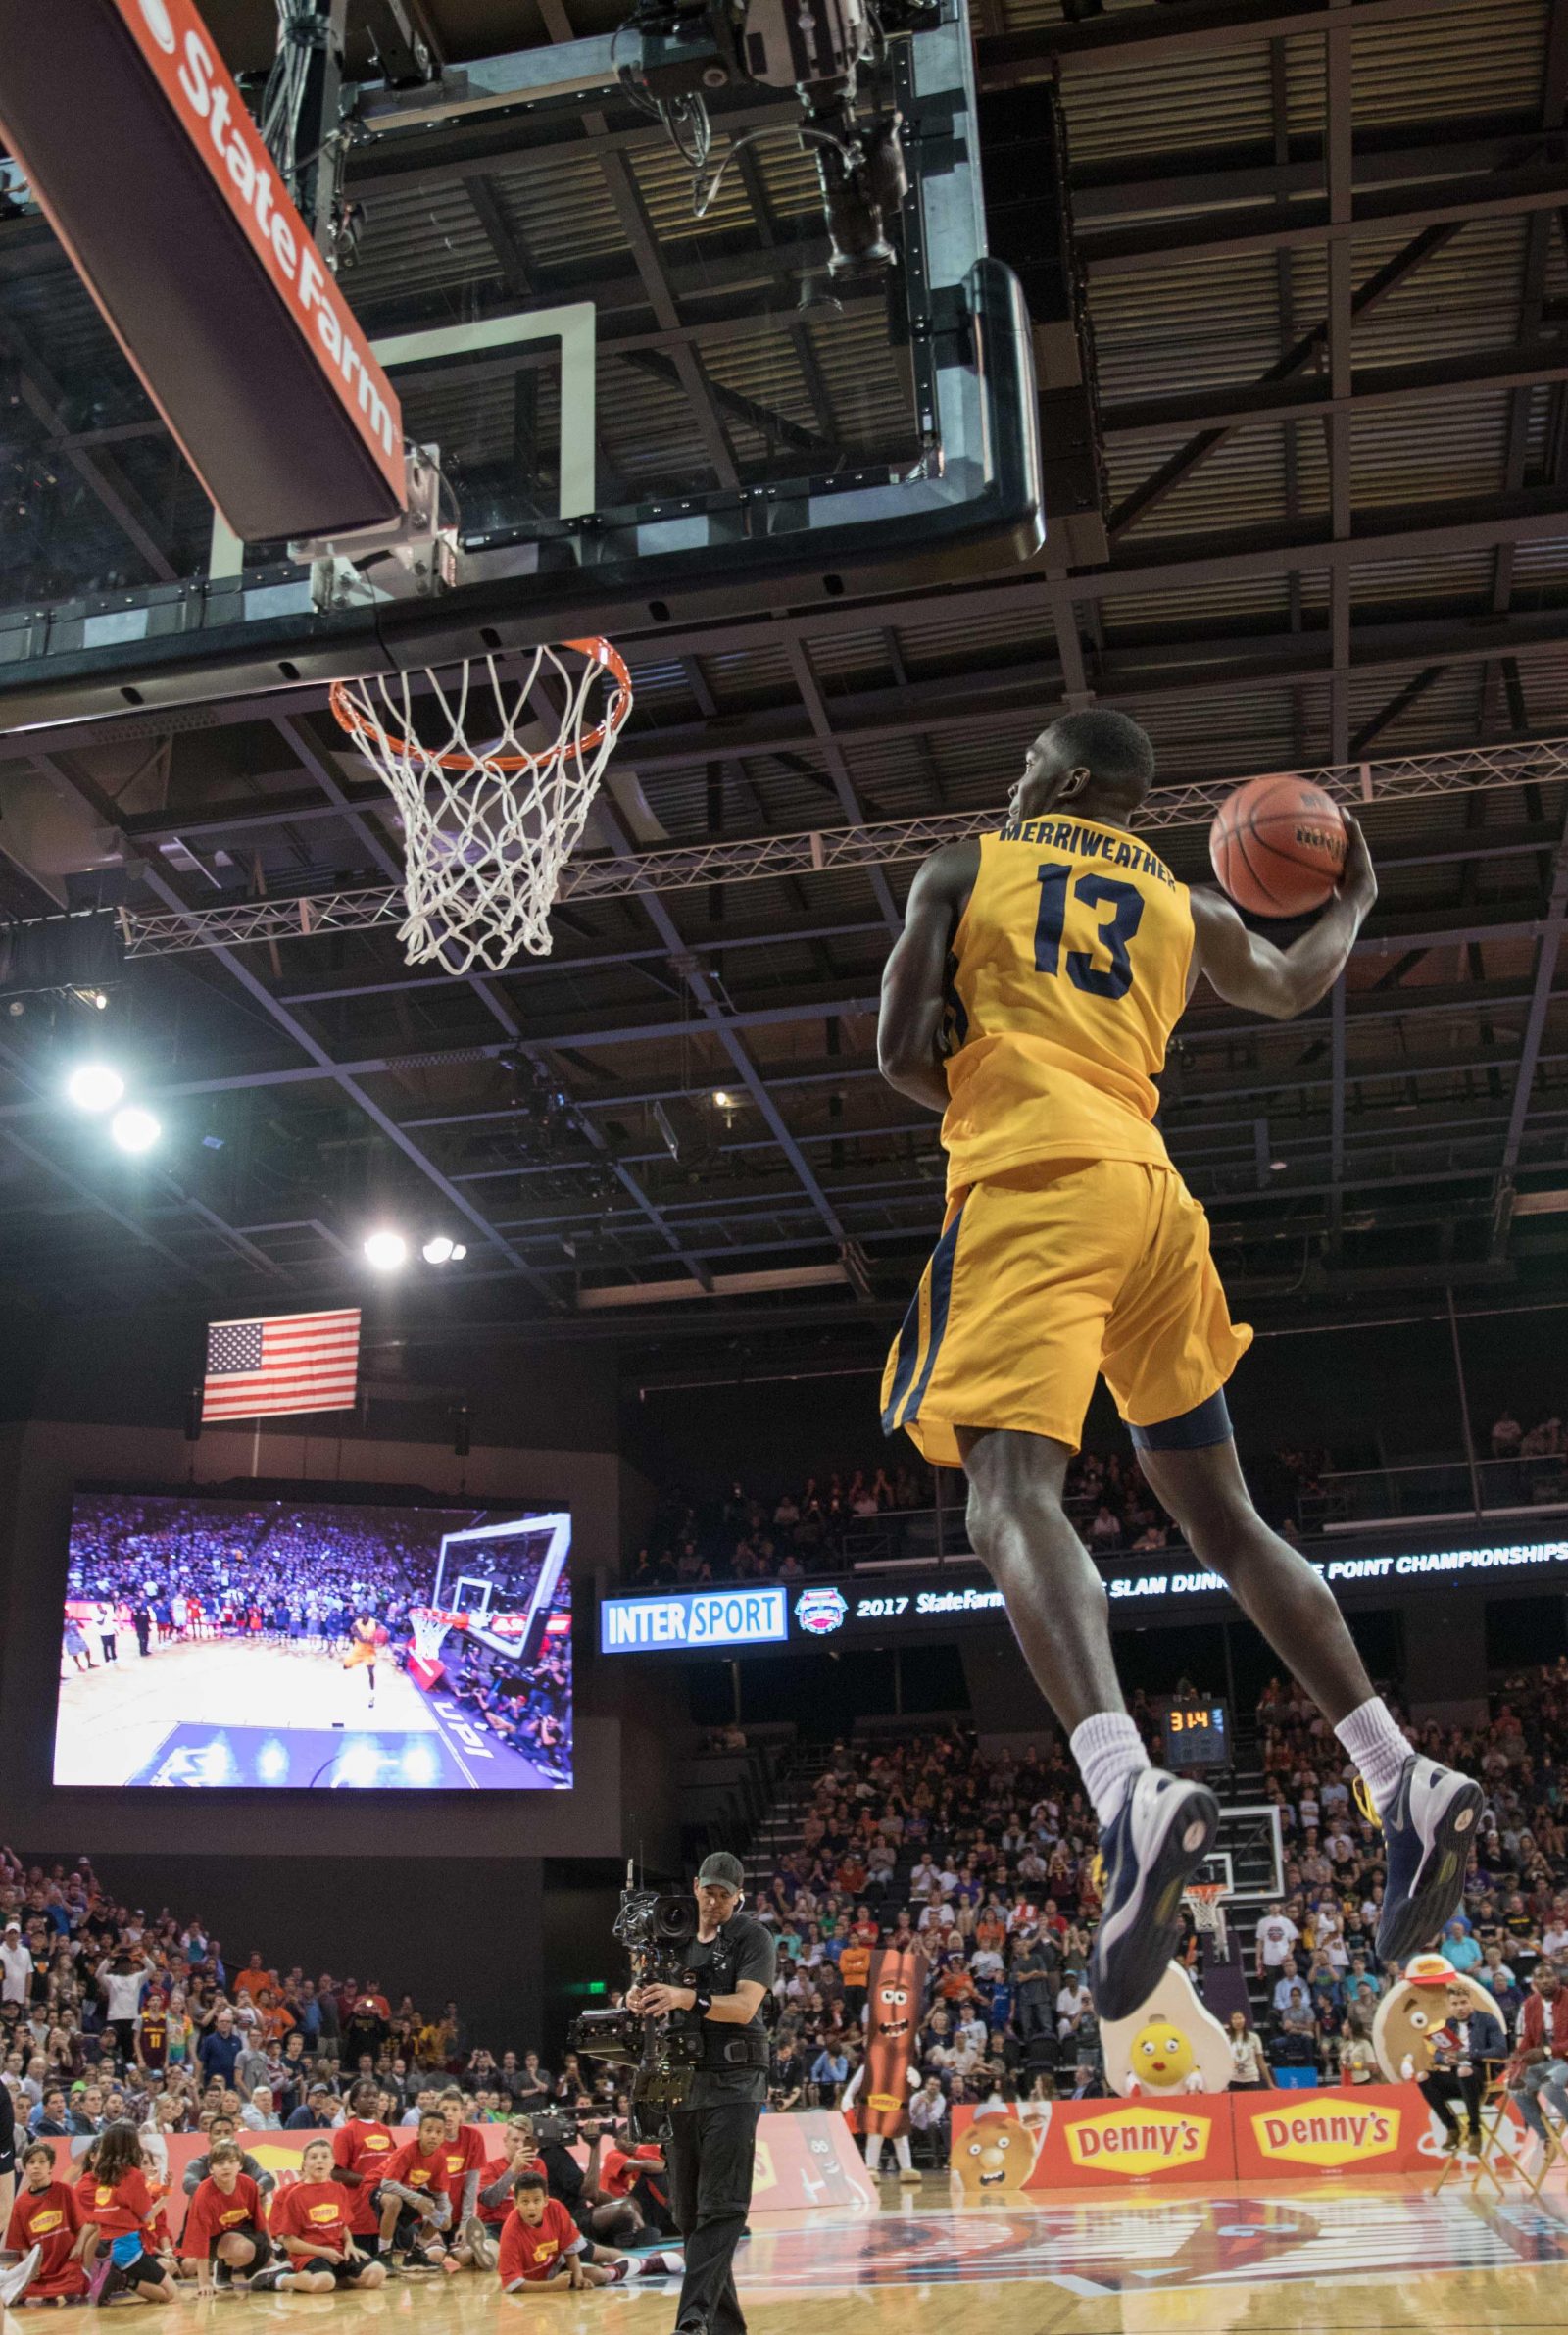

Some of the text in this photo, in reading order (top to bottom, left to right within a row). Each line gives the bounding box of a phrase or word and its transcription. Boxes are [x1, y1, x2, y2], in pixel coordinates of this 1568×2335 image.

[1034, 862, 1145, 1001] 13
[856, 1597, 909, 1618] 2017
[1109, 1576, 1167, 1599] SLAM
[1329, 1557, 1394, 1580] POINT
[1396, 1541, 1568, 1574] CHAMPIONSHIPS
[1077, 2120, 1200, 2158] Denny's
[1258, 2111, 1389, 2150] Denny's
